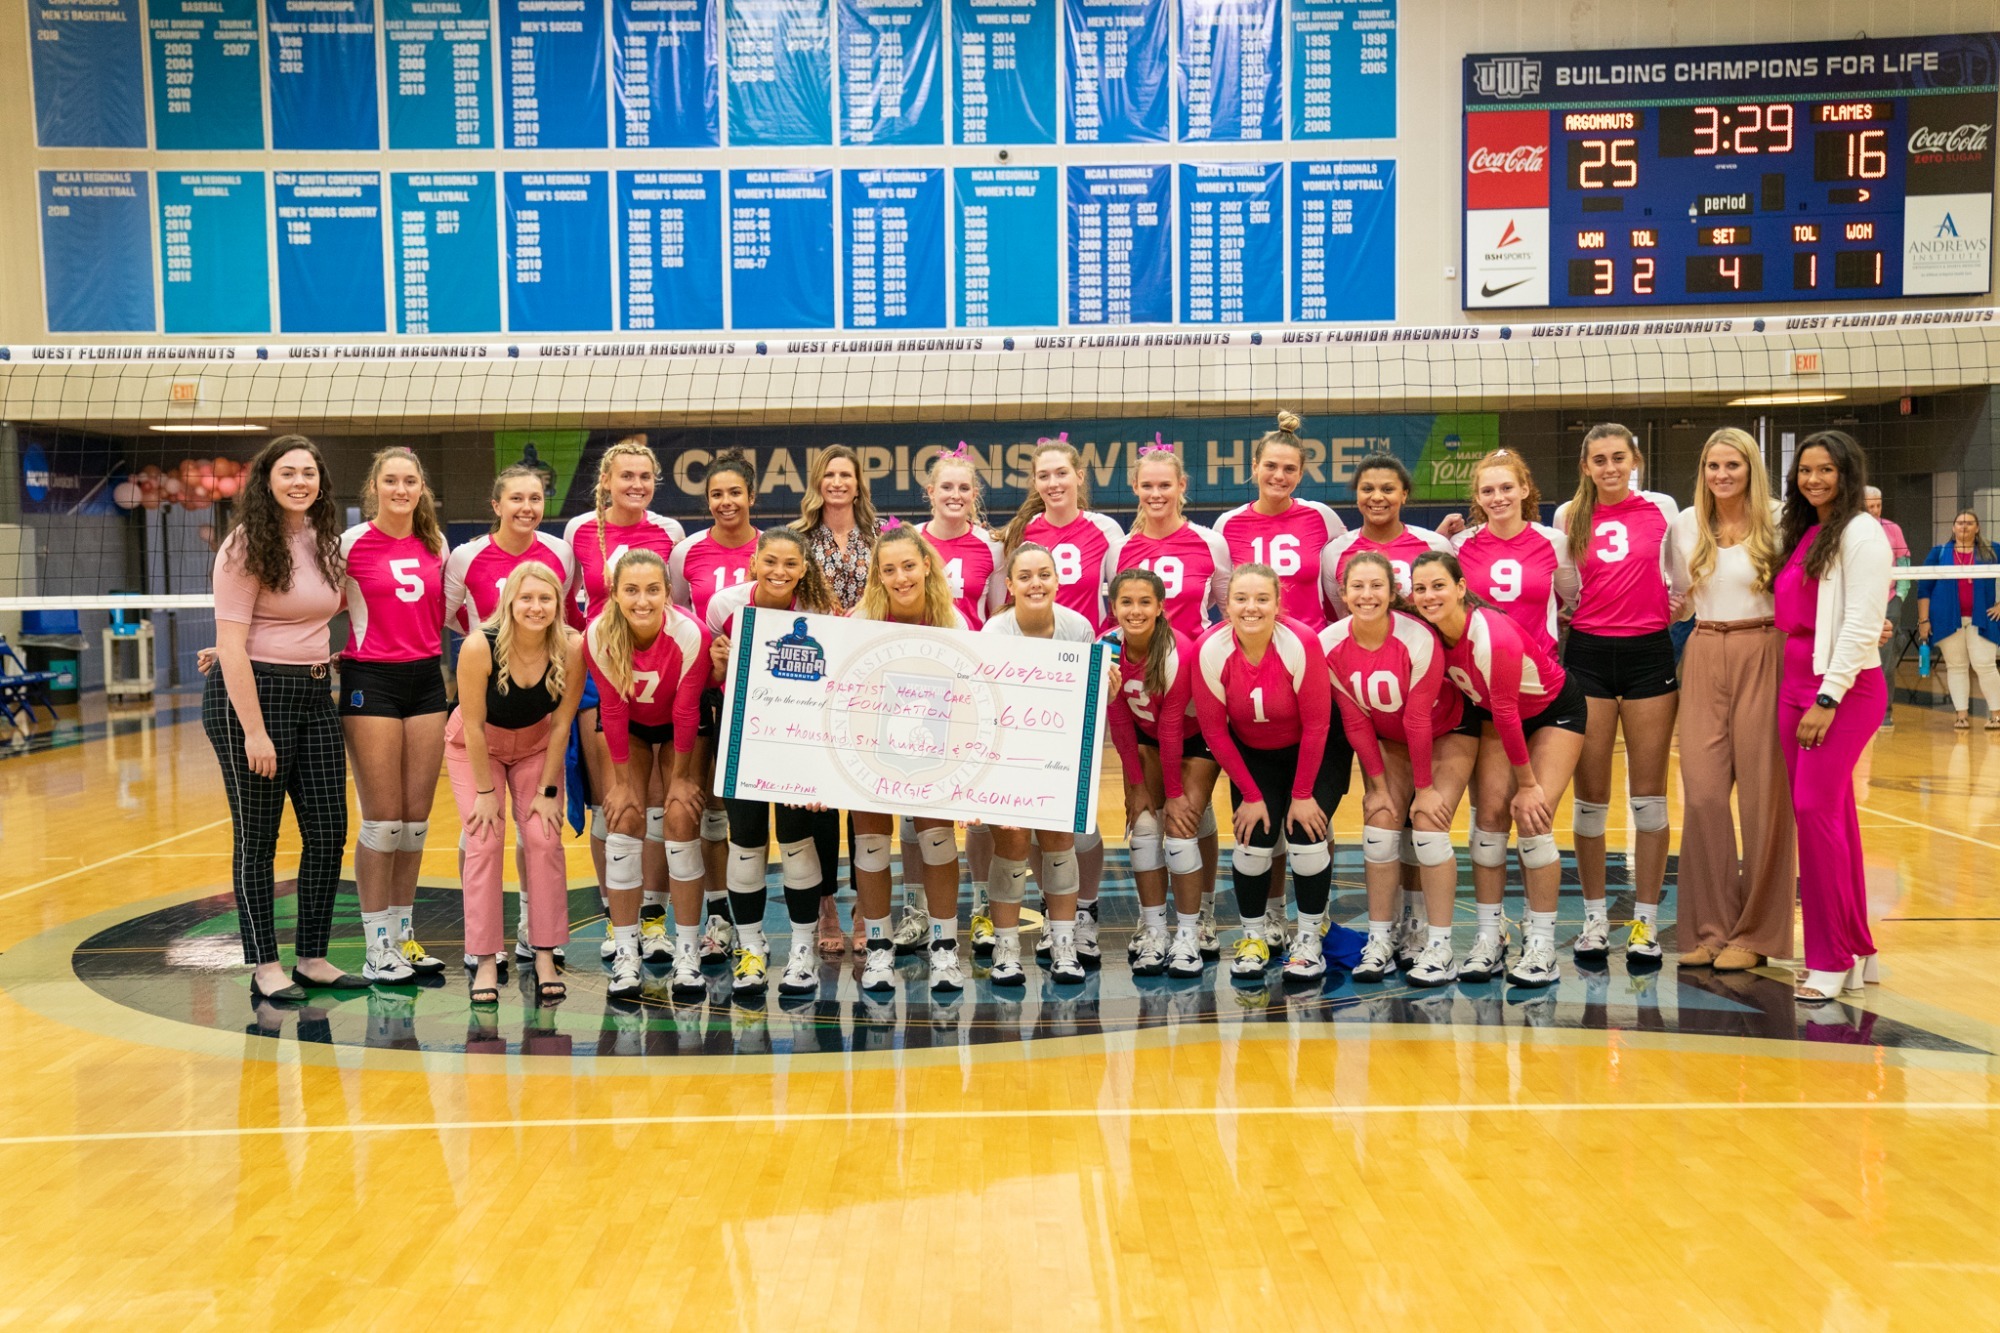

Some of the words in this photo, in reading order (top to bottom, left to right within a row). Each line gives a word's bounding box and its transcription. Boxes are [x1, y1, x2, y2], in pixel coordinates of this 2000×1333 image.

[1306, 35, 1330, 46] 1995
[1362, 33, 1387, 45] 1998
[165, 44, 192, 55] 2003
[224, 44, 250, 55] 2007
[1361, 48, 1387, 59] 2004
[166, 58, 193, 70] 2004
[1361, 62, 1387, 74] 2005
[1557, 64, 1666, 85] BUILDING
[1673, 58, 1819, 84] CHAMPIONS
[1827, 56, 1874, 75] FOR
[1884, 52, 1938, 72] LIFE
[167, 72, 193, 84] 2007
[1472, 56, 1543, 98] UWF
[1305, 92, 1330, 104] 2002
[169, 102, 190, 112] 2011
[1305, 106, 1330, 118] 2003
[1821, 104, 1873, 122] FLAMES
[1305, 120, 1330, 132] 2006
[1564, 113, 1634, 131] ARGONAUTS
[1693, 104, 1794, 155] 3:29
[1907, 124, 1992, 154] Coca-Cola
[1468, 145, 1548, 174] Coca-Cola
[1847, 130, 1887, 178] 16
[1914, 153, 1943, 164] zero
[1945, 152, 1982, 163] SUGAR
[1310, 165, 1331, 174] NCAA
[1334, 164, 1377, 175] REGIONALS
[1578, 139, 1638, 189] 25
[747, 173, 769, 182] NCAA
[972, 171, 994, 180] NCAA
[996, 170, 1039, 180] REGIONALS
[975, 187, 1013, 196] WOMEN'S
[1015, 186, 1035, 196] GOLF
[1303, 180, 1340, 190] WOMEN'S
[1343, 180, 1383, 190] SOFTBALL
[735, 189, 773, 199] WOMEN'S
[775, 188, 826, 198] BASKETBALL
[1704, 193, 1746, 214] period
[1332, 212, 1352, 222] 2017
[1631, 230, 1655, 247] TOL
[1711, 228, 1737, 244] SET
[1793, 226, 1816, 242] TOL
[1845, 223, 1872, 239] WON
[965, 241, 987, 252] 2007
[1578, 232, 1605, 248] WON
[1908, 239, 1987, 253] ANDREWS
[734, 246, 770, 256] 2014-15
[1504, 252, 1531, 260] SPORTS
[1912, 253, 1980, 261] INSTITUTE
[1633, 258, 1655, 294] 2
[1718, 257, 1739, 289] 4
[1807, 255, 1816, 286] 1
[1873, 252, 1882, 284] 1
[1593, 260, 1613, 294] 3
[966, 291, 988, 301] 2014
[1302, 308, 1326, 319] 2010
[1786, 316, 1826, 329] WEST
[1832, 312, 1897, 327] FLORIDA
[1901, 309, 1992, 324] ARGONAUTS
[1283, 332, 1322, 345] WEST
[1327, 330, 1388, 343] FLORIDA
[1393, 327, 1479, 341] ARGONAUTS
[1532, 326, 1570, 338] WEST
[1577, 322, 1639, 336] FLORIDA
[1644, 319, 1732, 334] ARGONAUTS
[788, 342, 827, 354] WEST
[832, 340, 892, 353] FLORIDA
[898, 338, 982, 351] ARGONAUTS
[1036, 337, 1075, 349] WEST
[1079, 335, 1139, 348] FLORIDA
[1145, 333, 1229, 346] ARGONAUTS
[33, 347, 73, 359] WEST
[80, 347, 142, 360] FLORIDA
[147, 347, 235, 359] ARGONAUTS
[290, 347, 328, 359] WEST
[335, 346, 396, 358] FLORIDA
[401, 346, 487, 358] ARGONAUTS
[540, 345, 579, 357] WEST
[585, 344, 644, 356] FLORIDA
[650, 342, 734, 356] ARGONAUTS
[1796, 354, 1817, 371] EXIT
[173, 384, 195, 400] EXIT
[1594, 520, 1630, 564] 3
[1250, 533, 1302, 577] 16
[388, 558, 426, 603] 5
[1488, 558, 1522, 602] 9
[780, 648, 818, 662] WEST
[1058, 652, 1080, 663] 1001
[769, 653, 825, 675] FLORIDA
[777, 671, 815, 680] ARGONAUTS
[751, 687, 775, 705] Pay
[782, 694, 796, 703] the
[796, 697, 817, 708] order
[943, 685, 972, 705] CARE
[1349, 669, 1403, 713] 10
[1123, 679, 1155, 723] 2
[1044, 760, 1071, 772] dollars
[876, 776, 933, 801] ARGIE
[951, 783, 1056, 808] ARGONAUT
